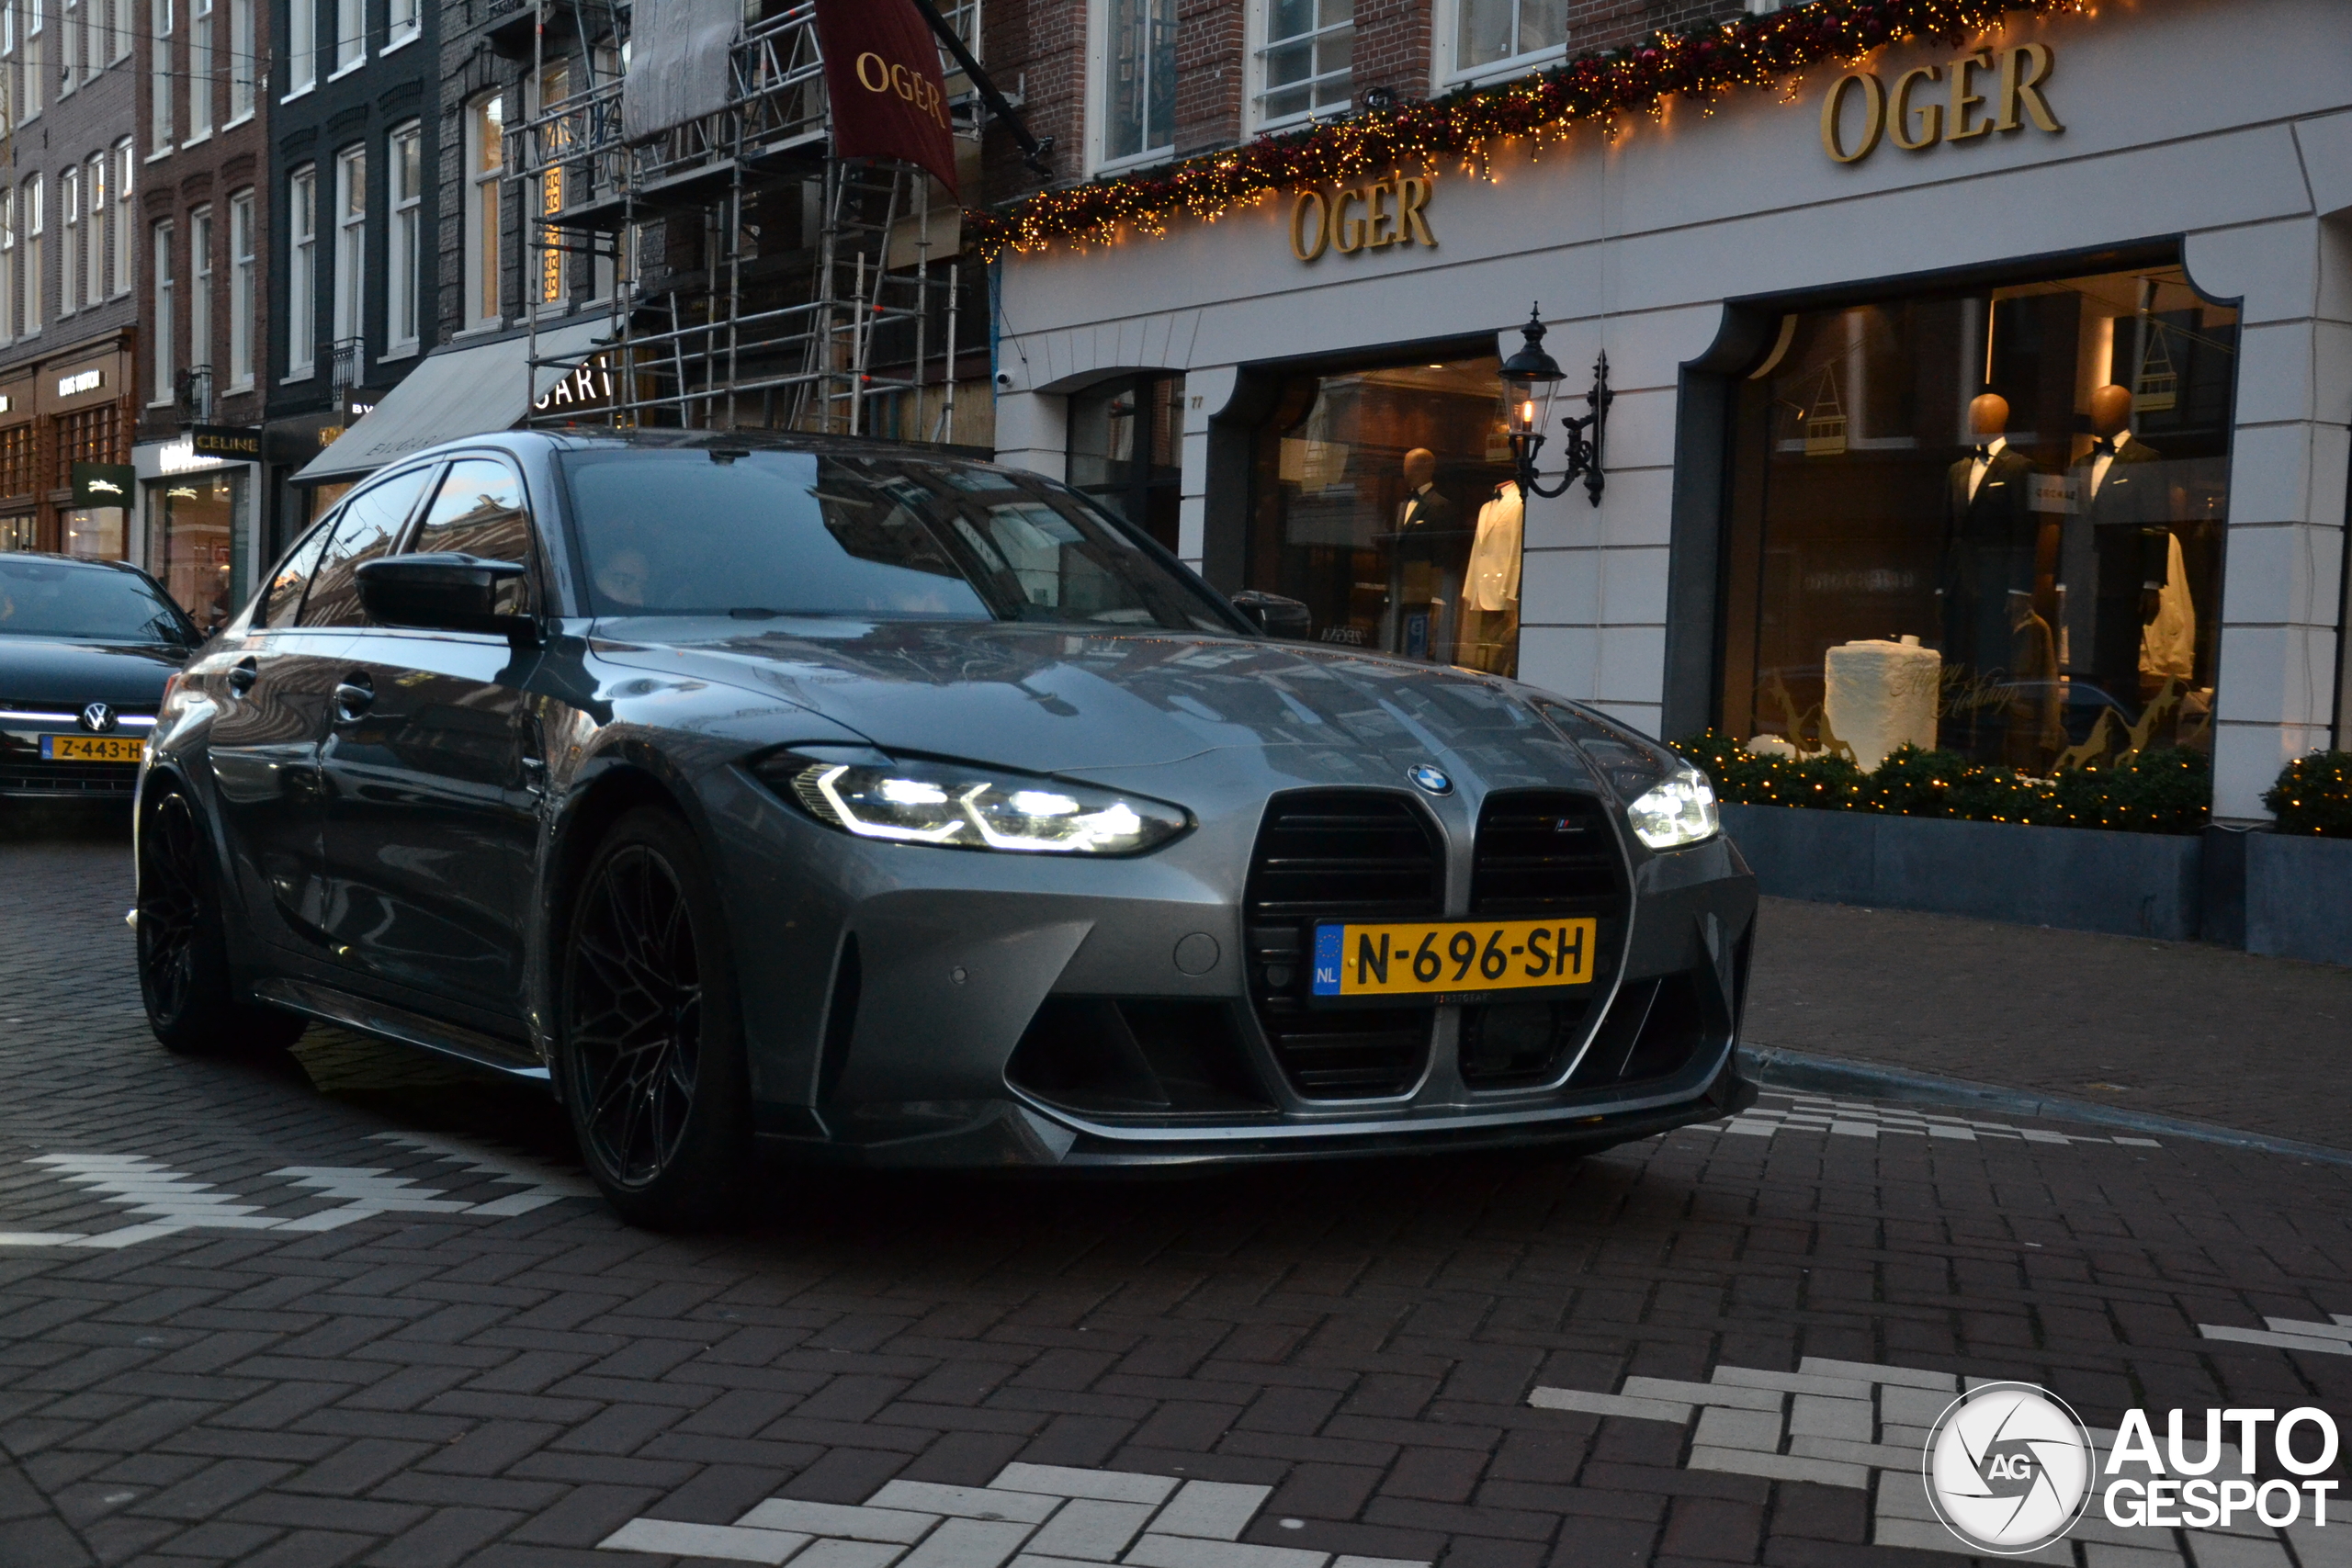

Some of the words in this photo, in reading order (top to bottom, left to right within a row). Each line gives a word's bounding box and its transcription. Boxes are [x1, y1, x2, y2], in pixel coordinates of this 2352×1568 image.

[1191, 396, 1204, 409] 77
[196, 434, 259, 452] CELINE
[1357, 927, 1583, 985] N-696-SH
[1317, 967, 1338, 984] NL
